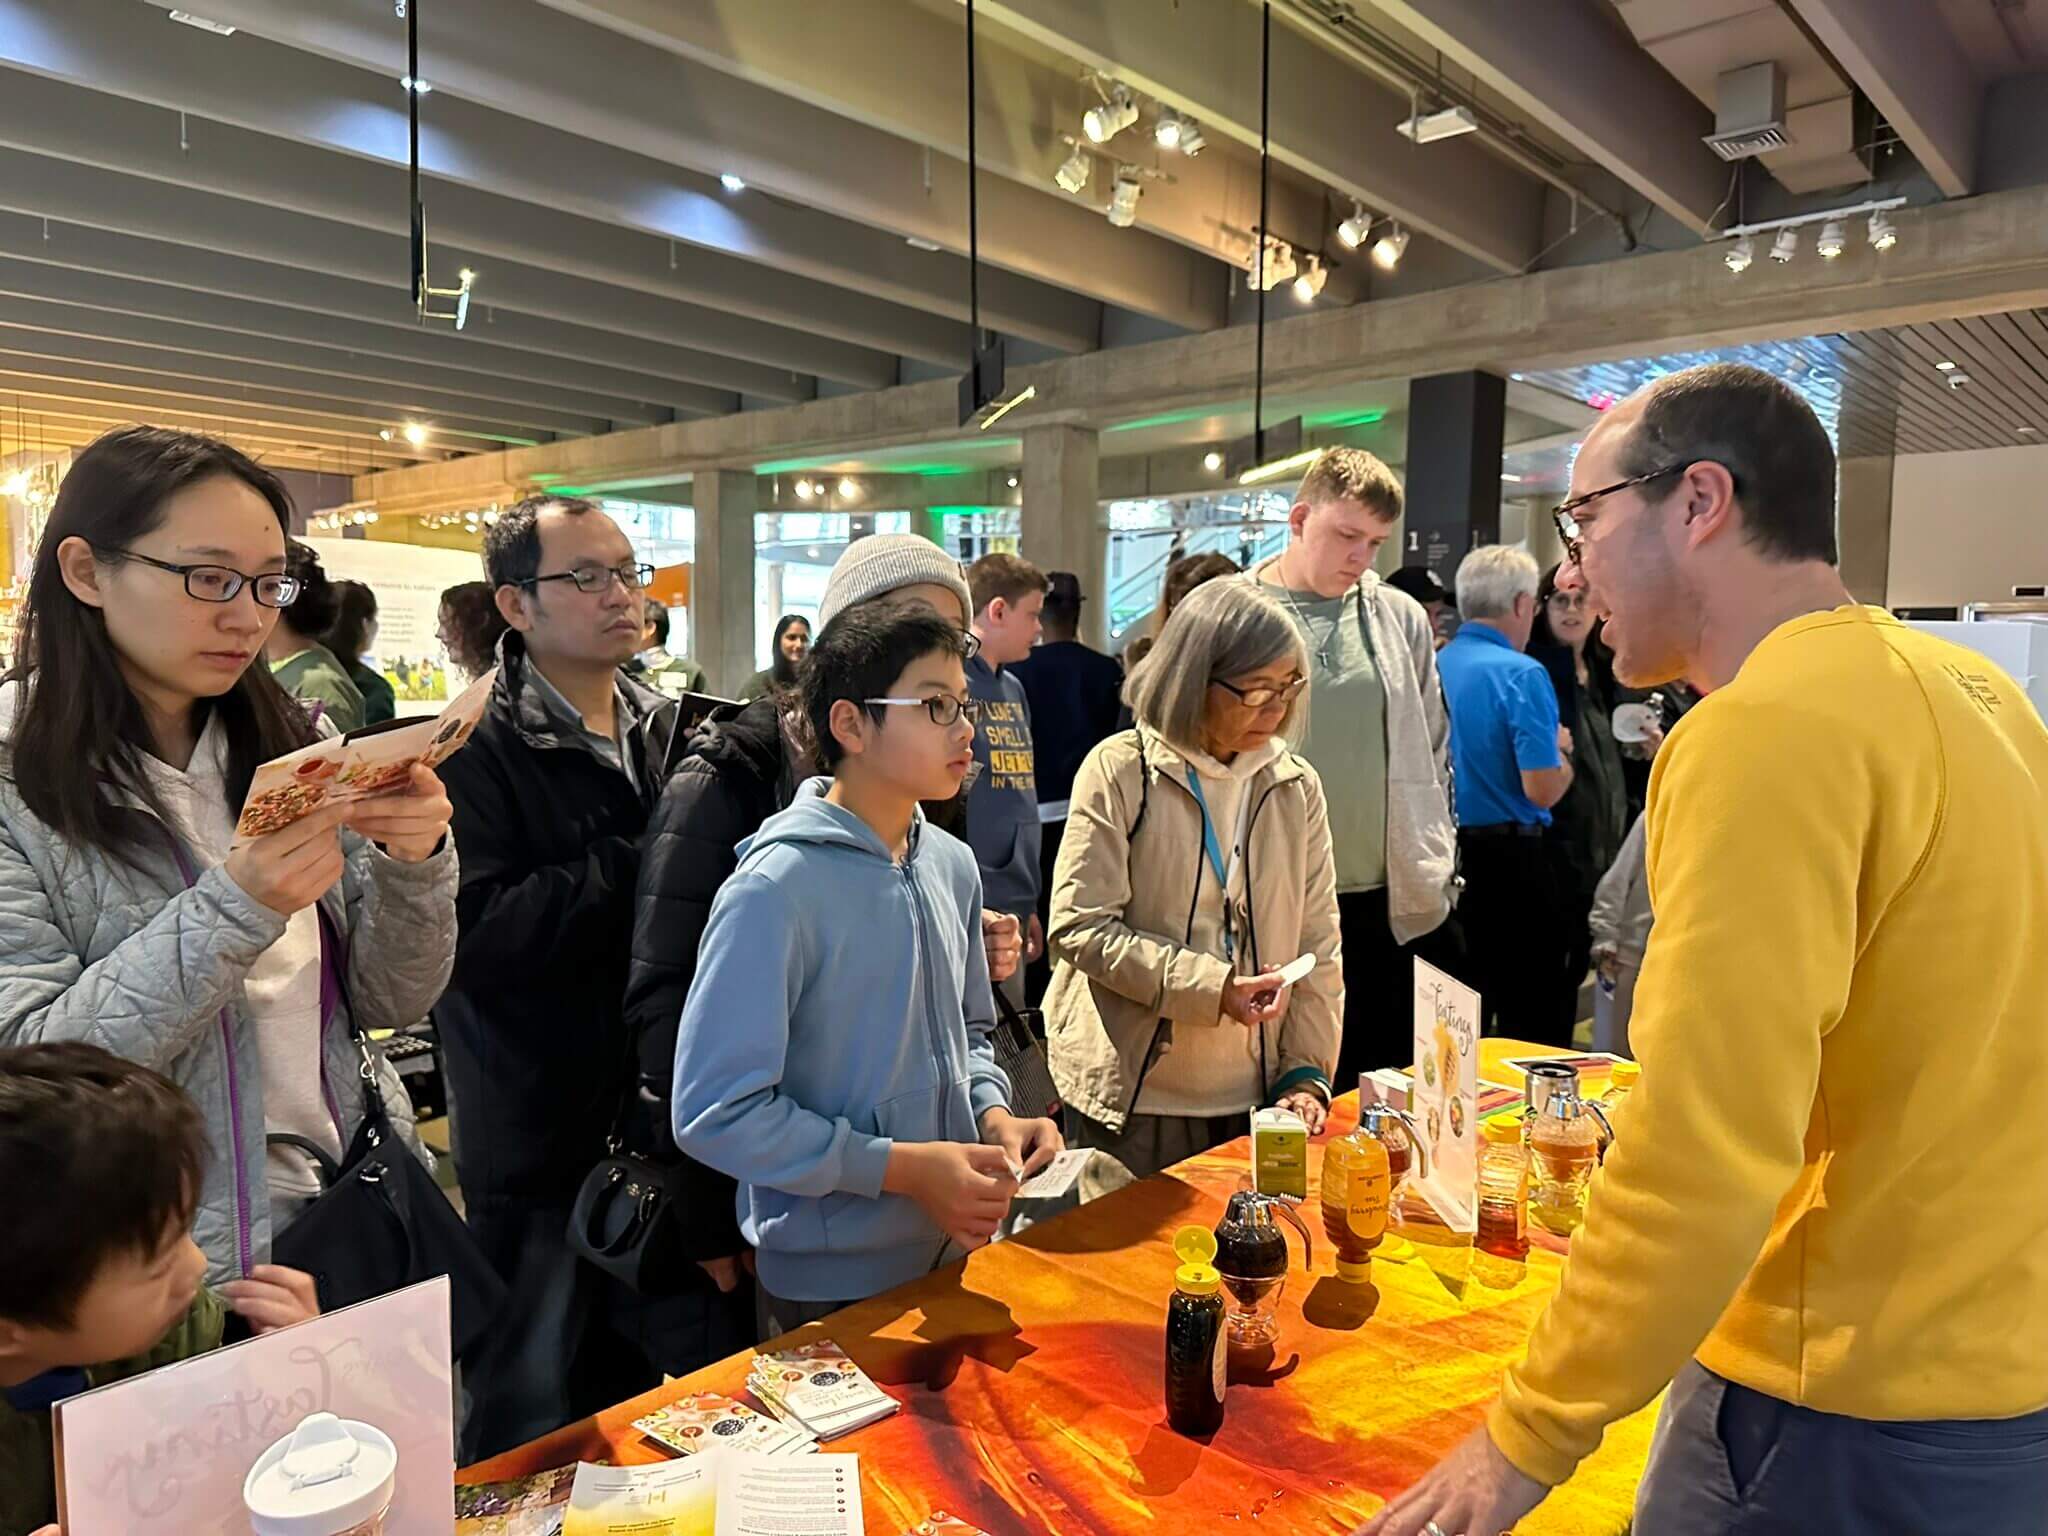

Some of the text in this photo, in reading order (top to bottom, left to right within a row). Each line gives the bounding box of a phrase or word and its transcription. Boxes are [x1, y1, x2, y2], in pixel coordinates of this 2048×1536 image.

[1408, 530, 1419, 551] 1
[985, 702, 1014, 721] LOVE
[986, 726, 1025, 747] SMELL
[993, 752, 1018, 772] JET
[992, 775, 1006, 789] IN
